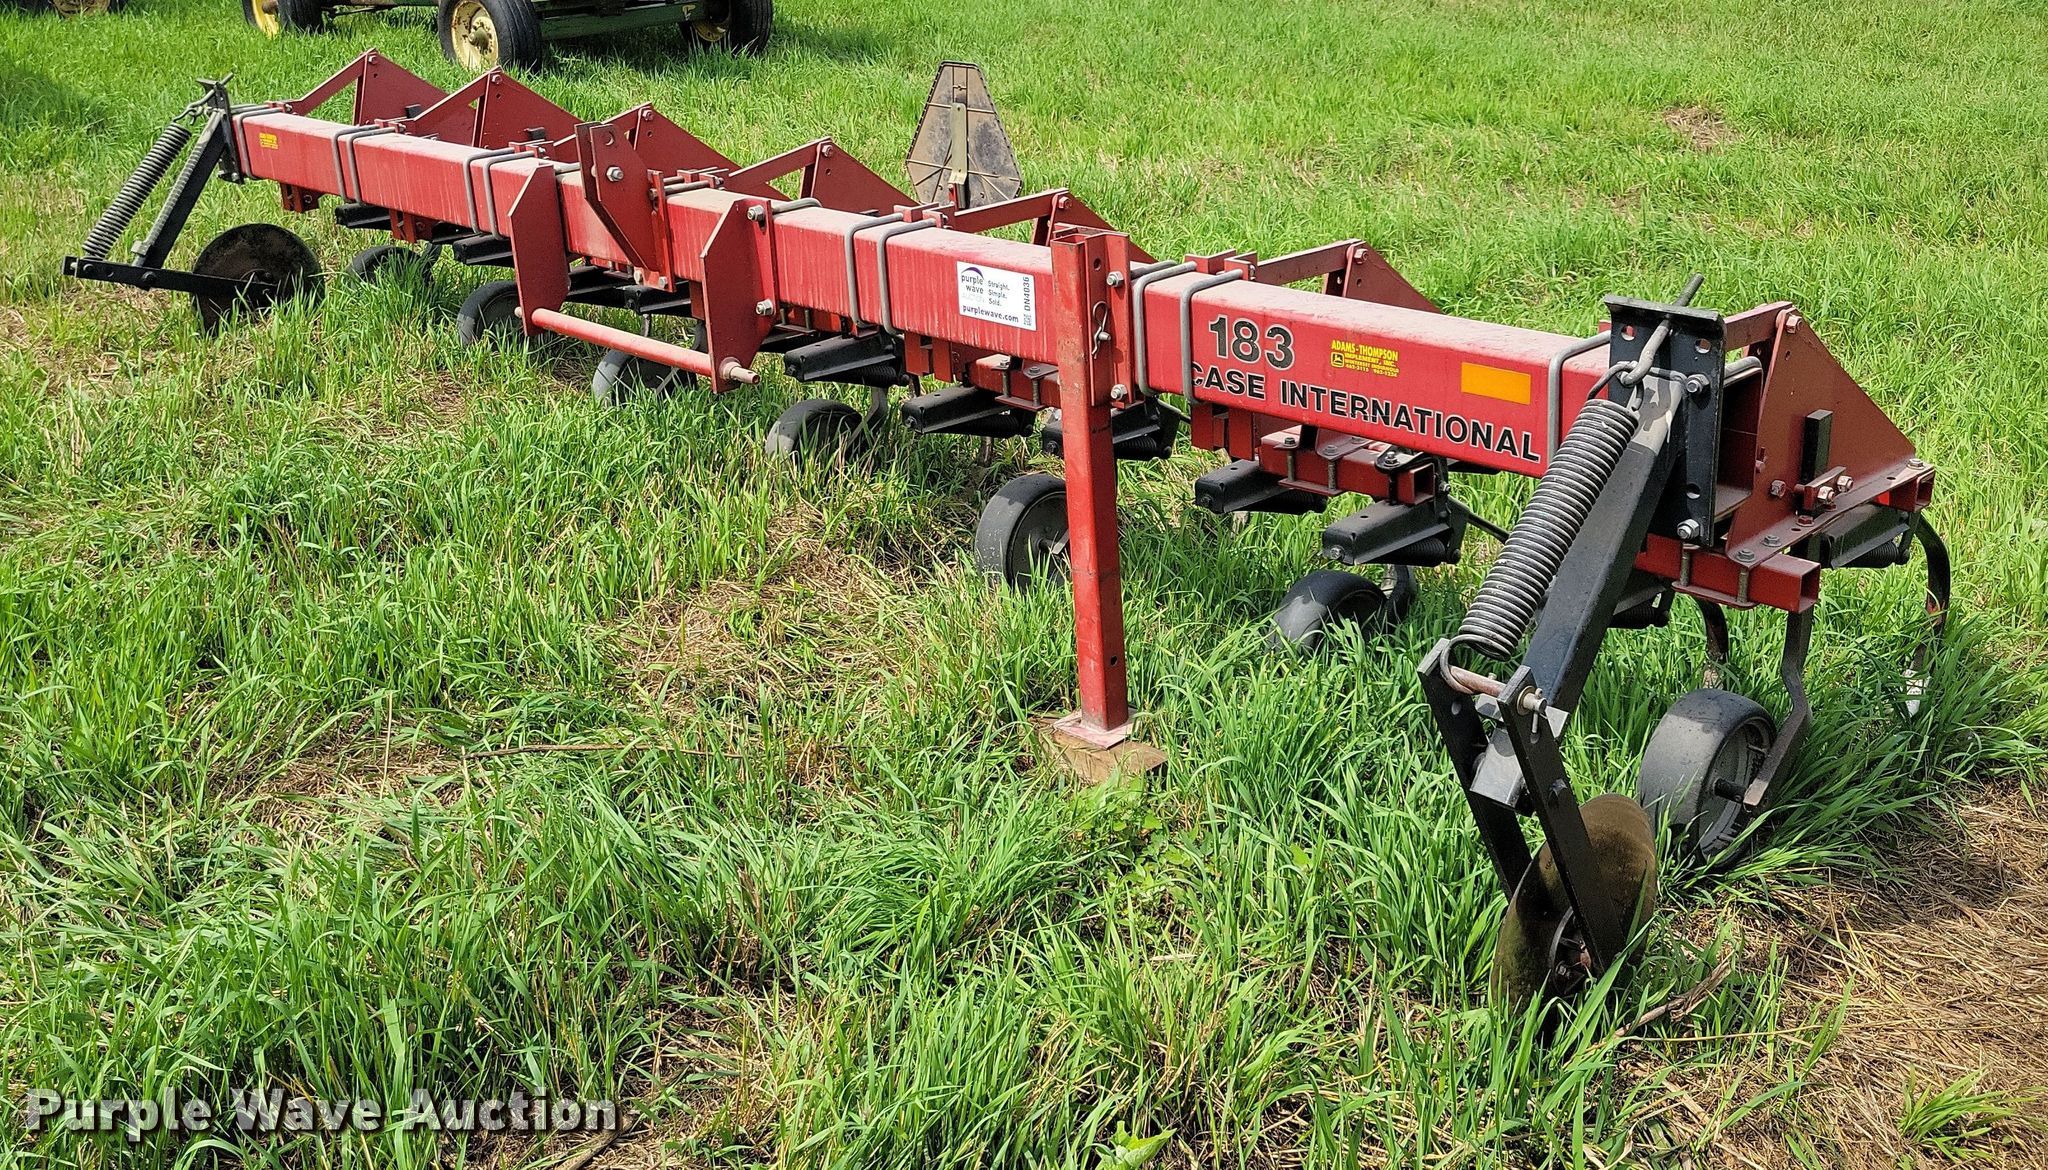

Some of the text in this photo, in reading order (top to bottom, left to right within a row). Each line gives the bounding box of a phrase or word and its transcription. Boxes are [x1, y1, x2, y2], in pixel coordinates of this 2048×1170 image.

[961, 275, 983, 286] purple
[966, 284, 984, 294] wave
[1022, 276, 1031, 311] DN4036
[962, 304, 1019, 323] purplewave.com
[1209, 314, 1295, 370] 183
[1331, 340, 1398, 361] ADAMS-THOMPSON
[1192, 361, 1540, 464] CASE INTERNATIONAL
